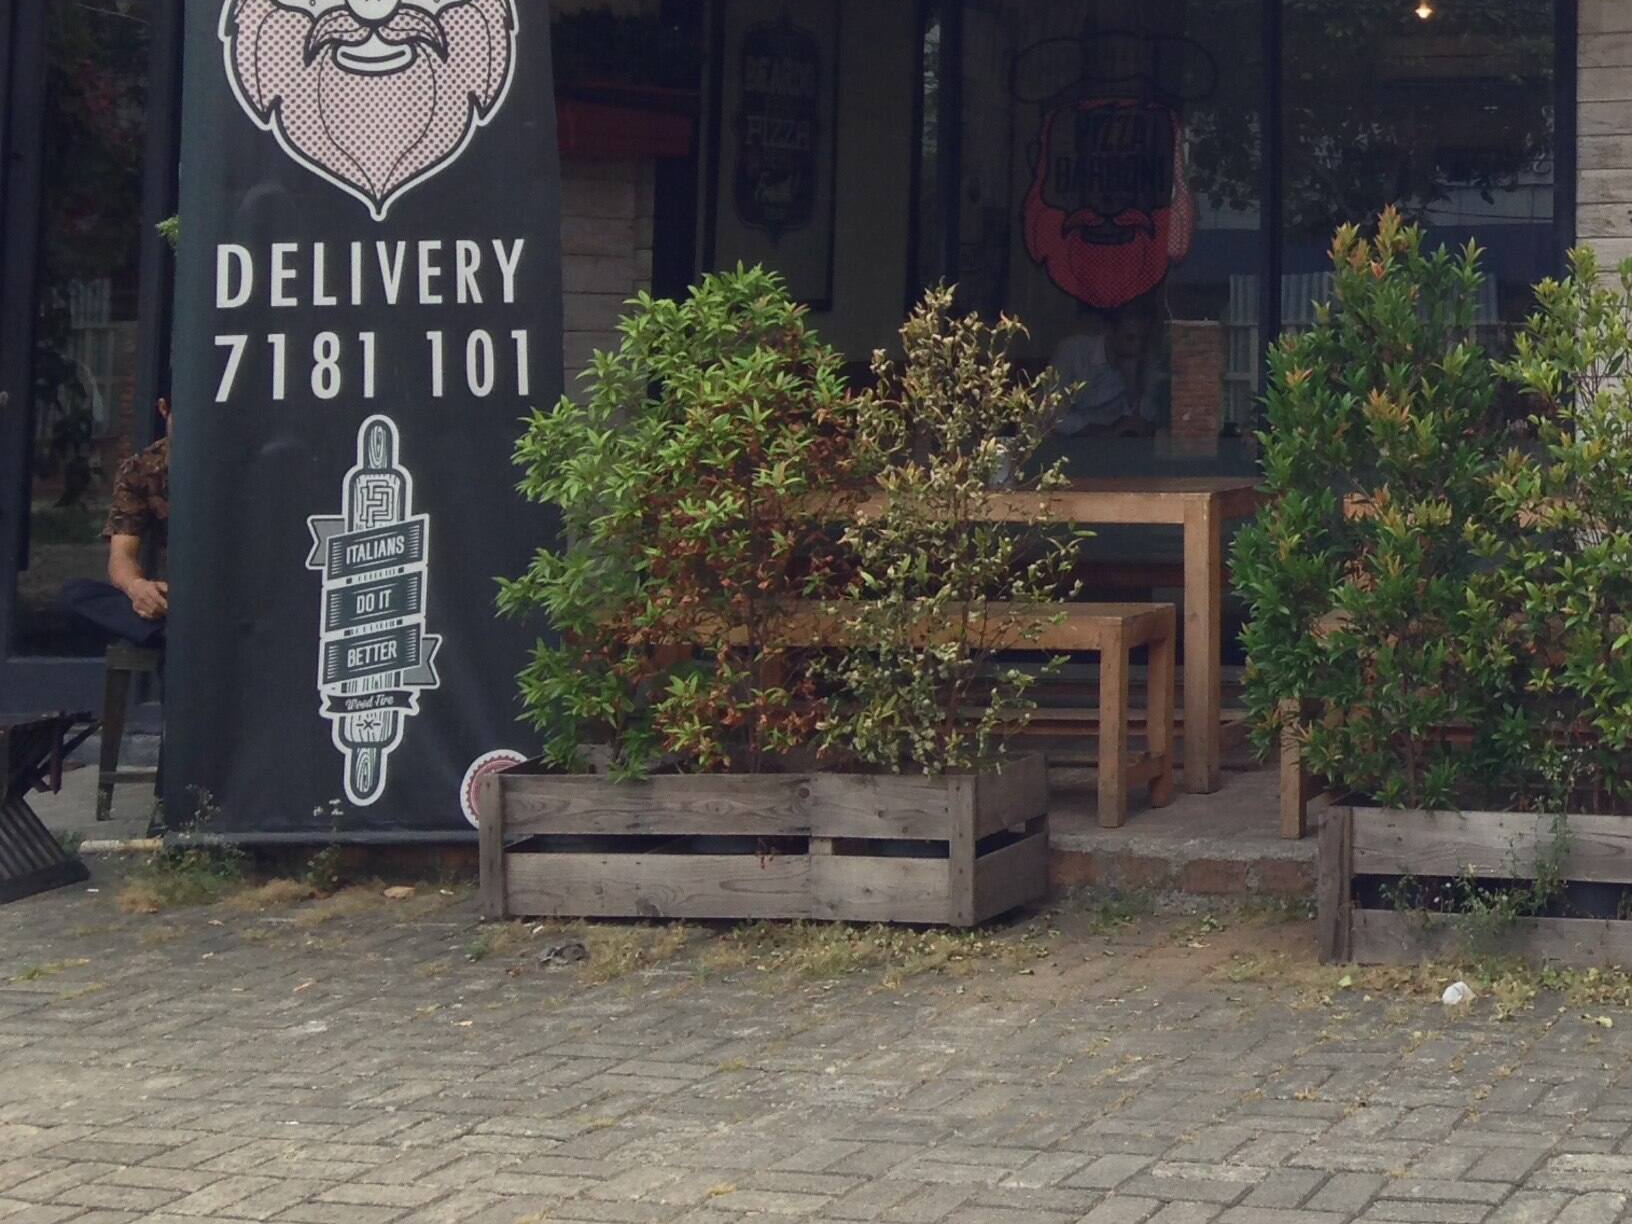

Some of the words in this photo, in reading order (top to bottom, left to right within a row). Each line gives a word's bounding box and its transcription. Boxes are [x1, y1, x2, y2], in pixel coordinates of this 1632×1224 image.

[216, 238, 526, 309] DELIVERY
[214, 331, 375, 403] 7181
[426, 328, 530, 397] 101
[346, 535, 405, 565] ITALIANS
[356, 592, 376, 614] DO
[377, 588, 393, 609] IT
[347, 639, 398, 668] BETTER
